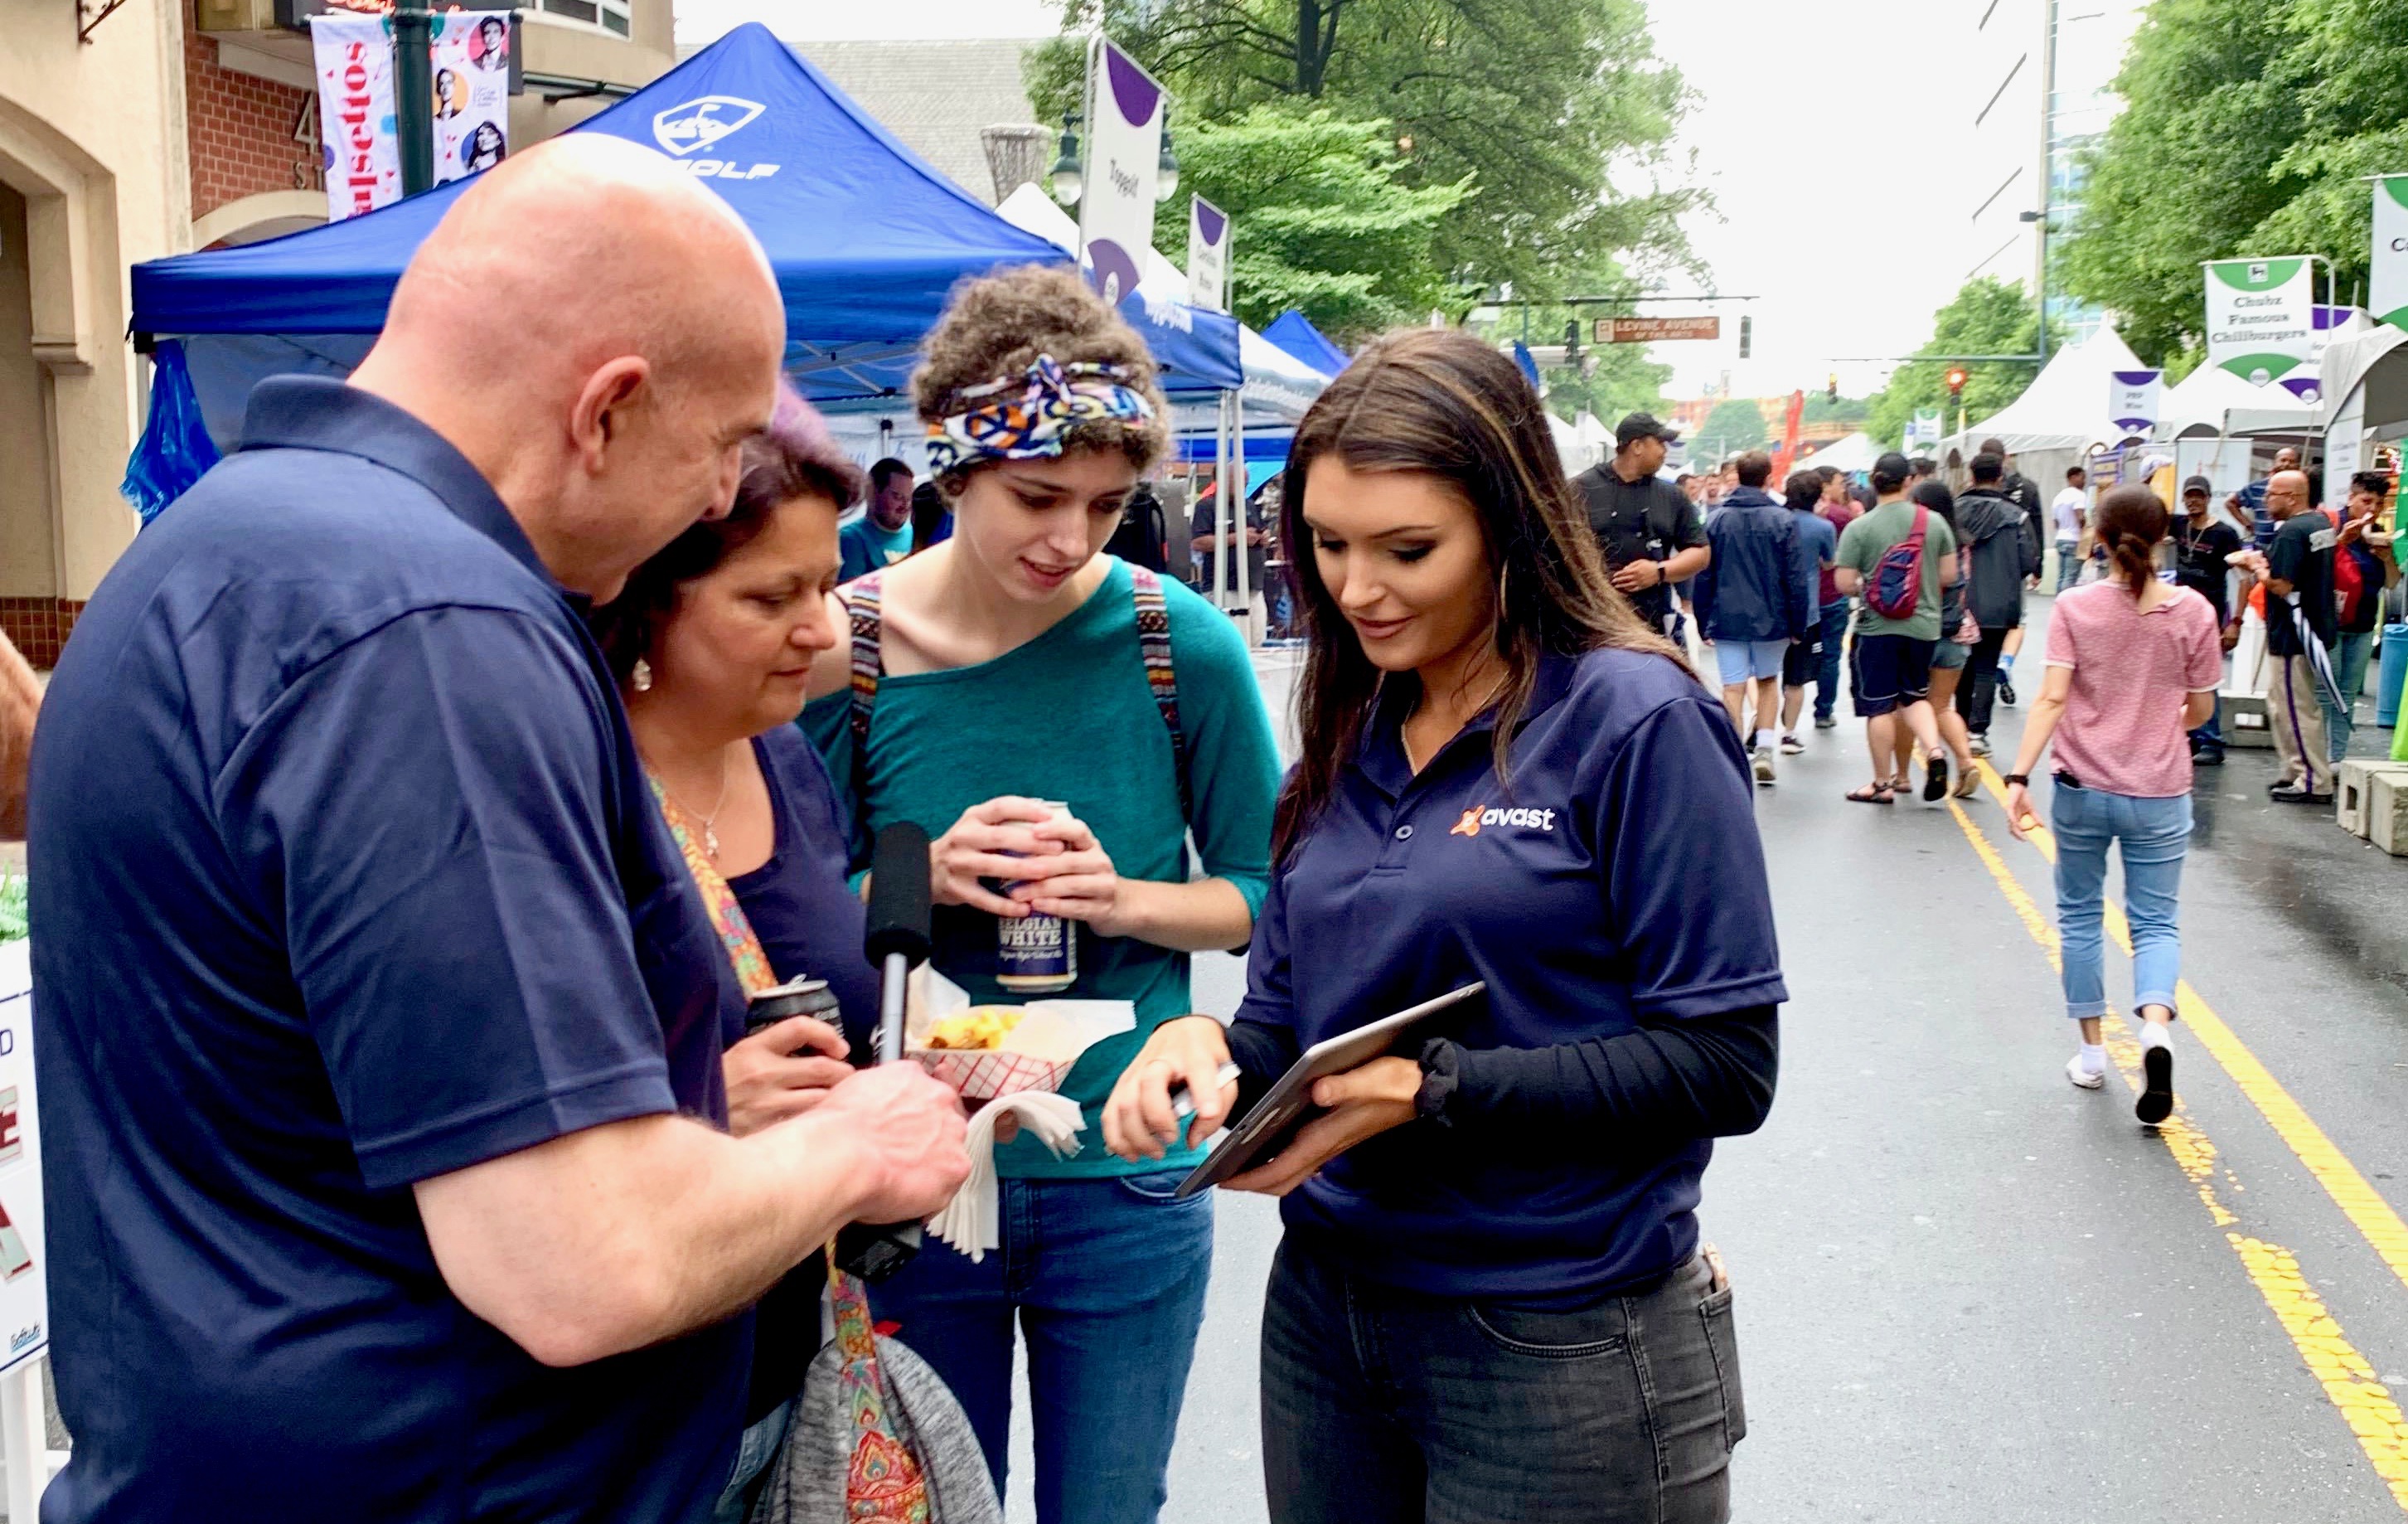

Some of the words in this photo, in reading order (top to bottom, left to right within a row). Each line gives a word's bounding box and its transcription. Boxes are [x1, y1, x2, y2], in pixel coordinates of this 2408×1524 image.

[675, 159, 781, 179] OLF
[2233, 295, 2283, 308] Chubz
[1615, 319, 1661, 332] LEVINE
[1664, 318, 1717, 330] AVENUE
[2227, 313, 2290, 325] Famous
[1480, 808, 1556, 831] avast
[999, 929, 1062, 946] WHITE
